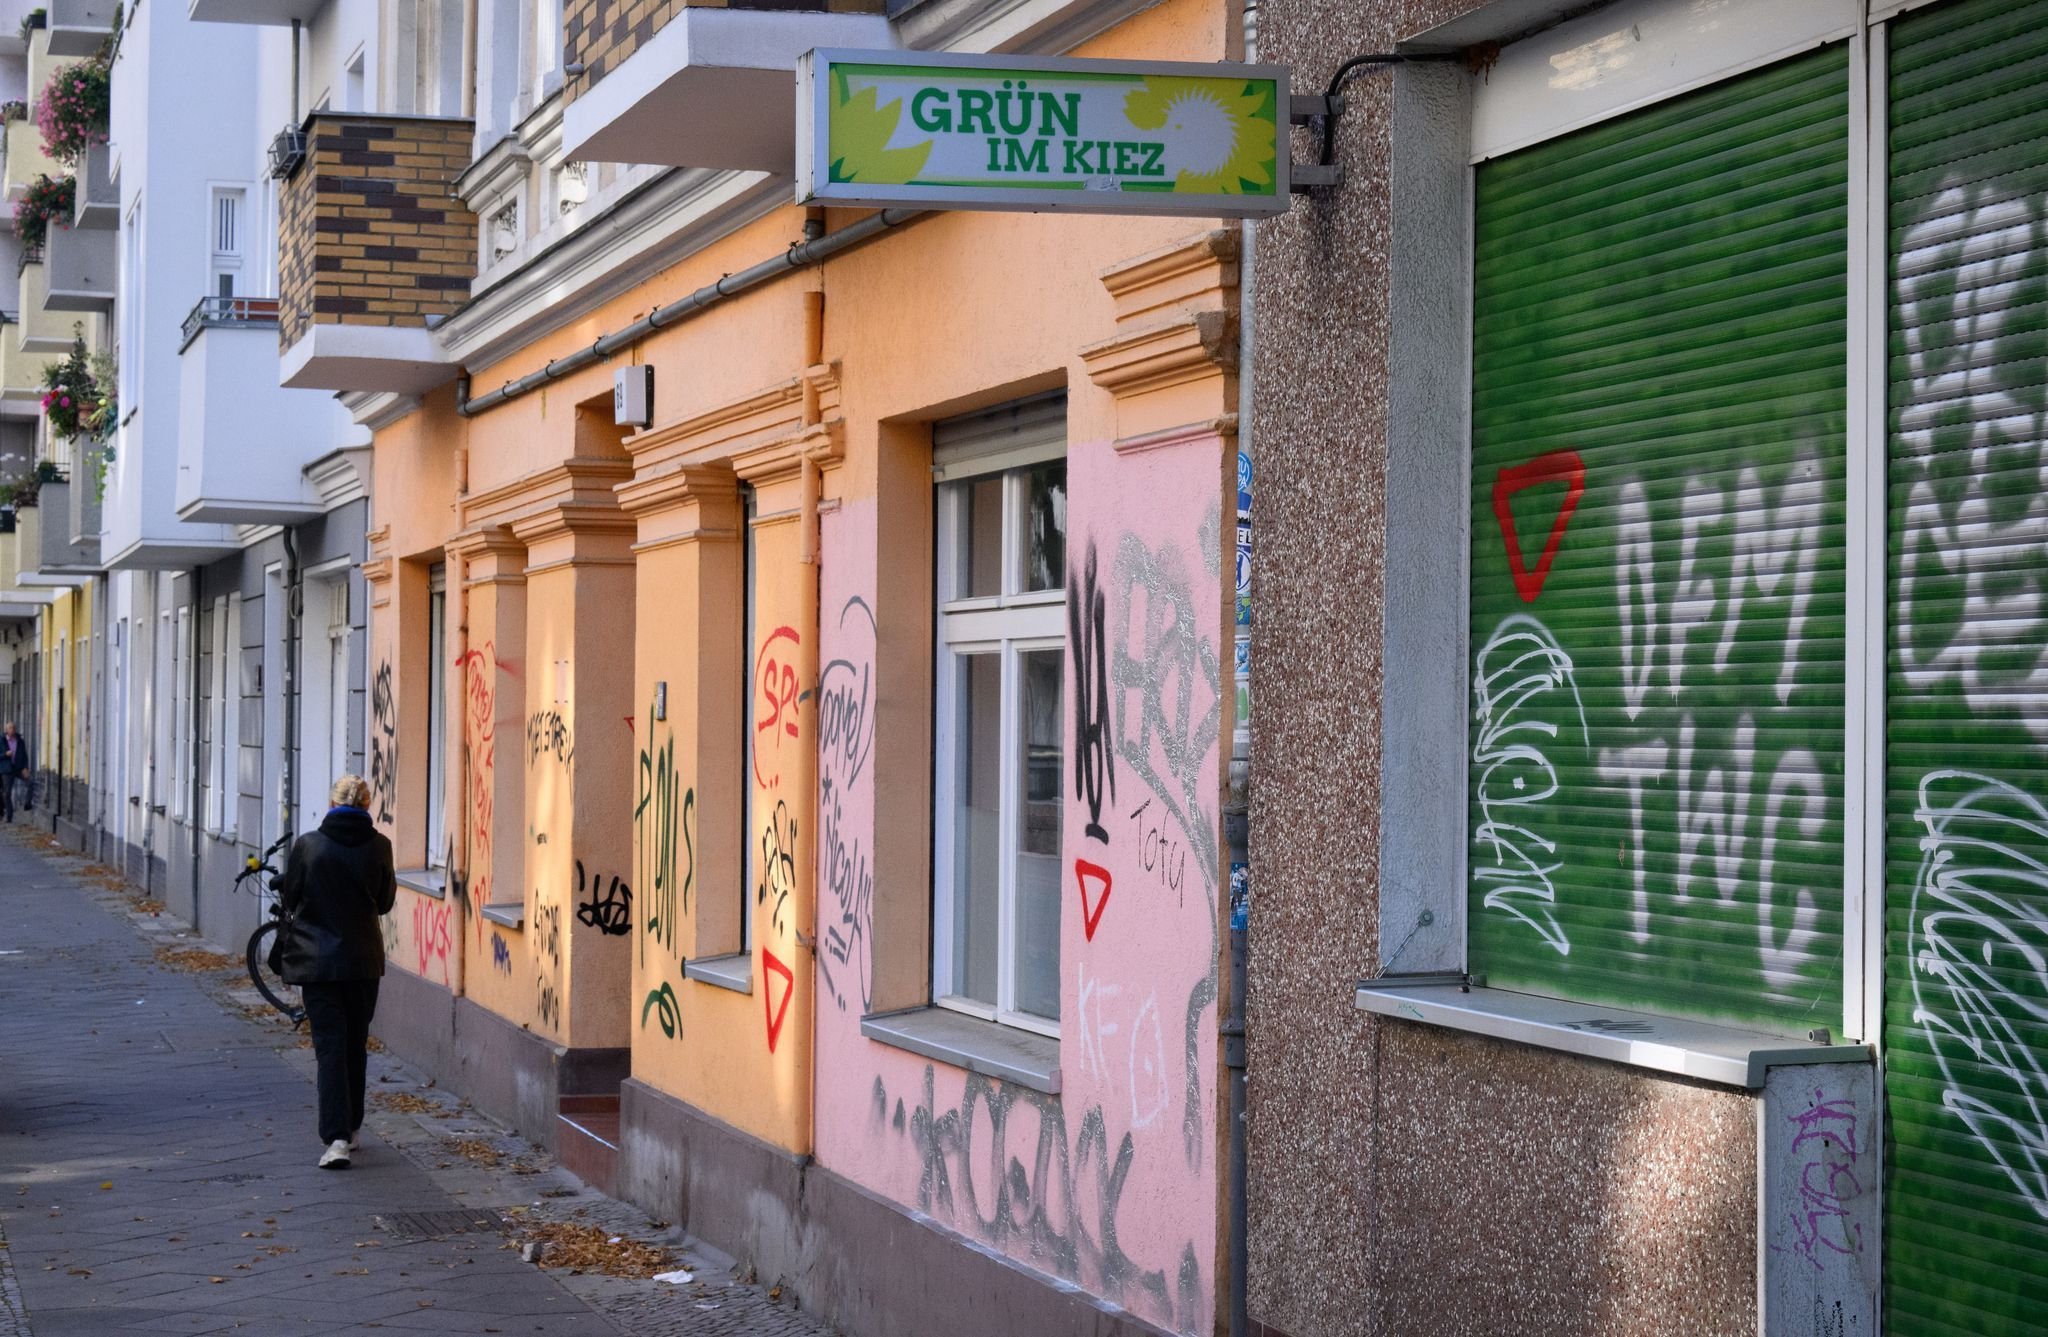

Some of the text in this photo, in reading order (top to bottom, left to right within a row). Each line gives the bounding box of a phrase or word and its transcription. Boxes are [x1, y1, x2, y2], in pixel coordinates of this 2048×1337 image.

[911, 80, 1082, 136] GRÜN
[986, 138, 1166, 176] IM KIEZ
